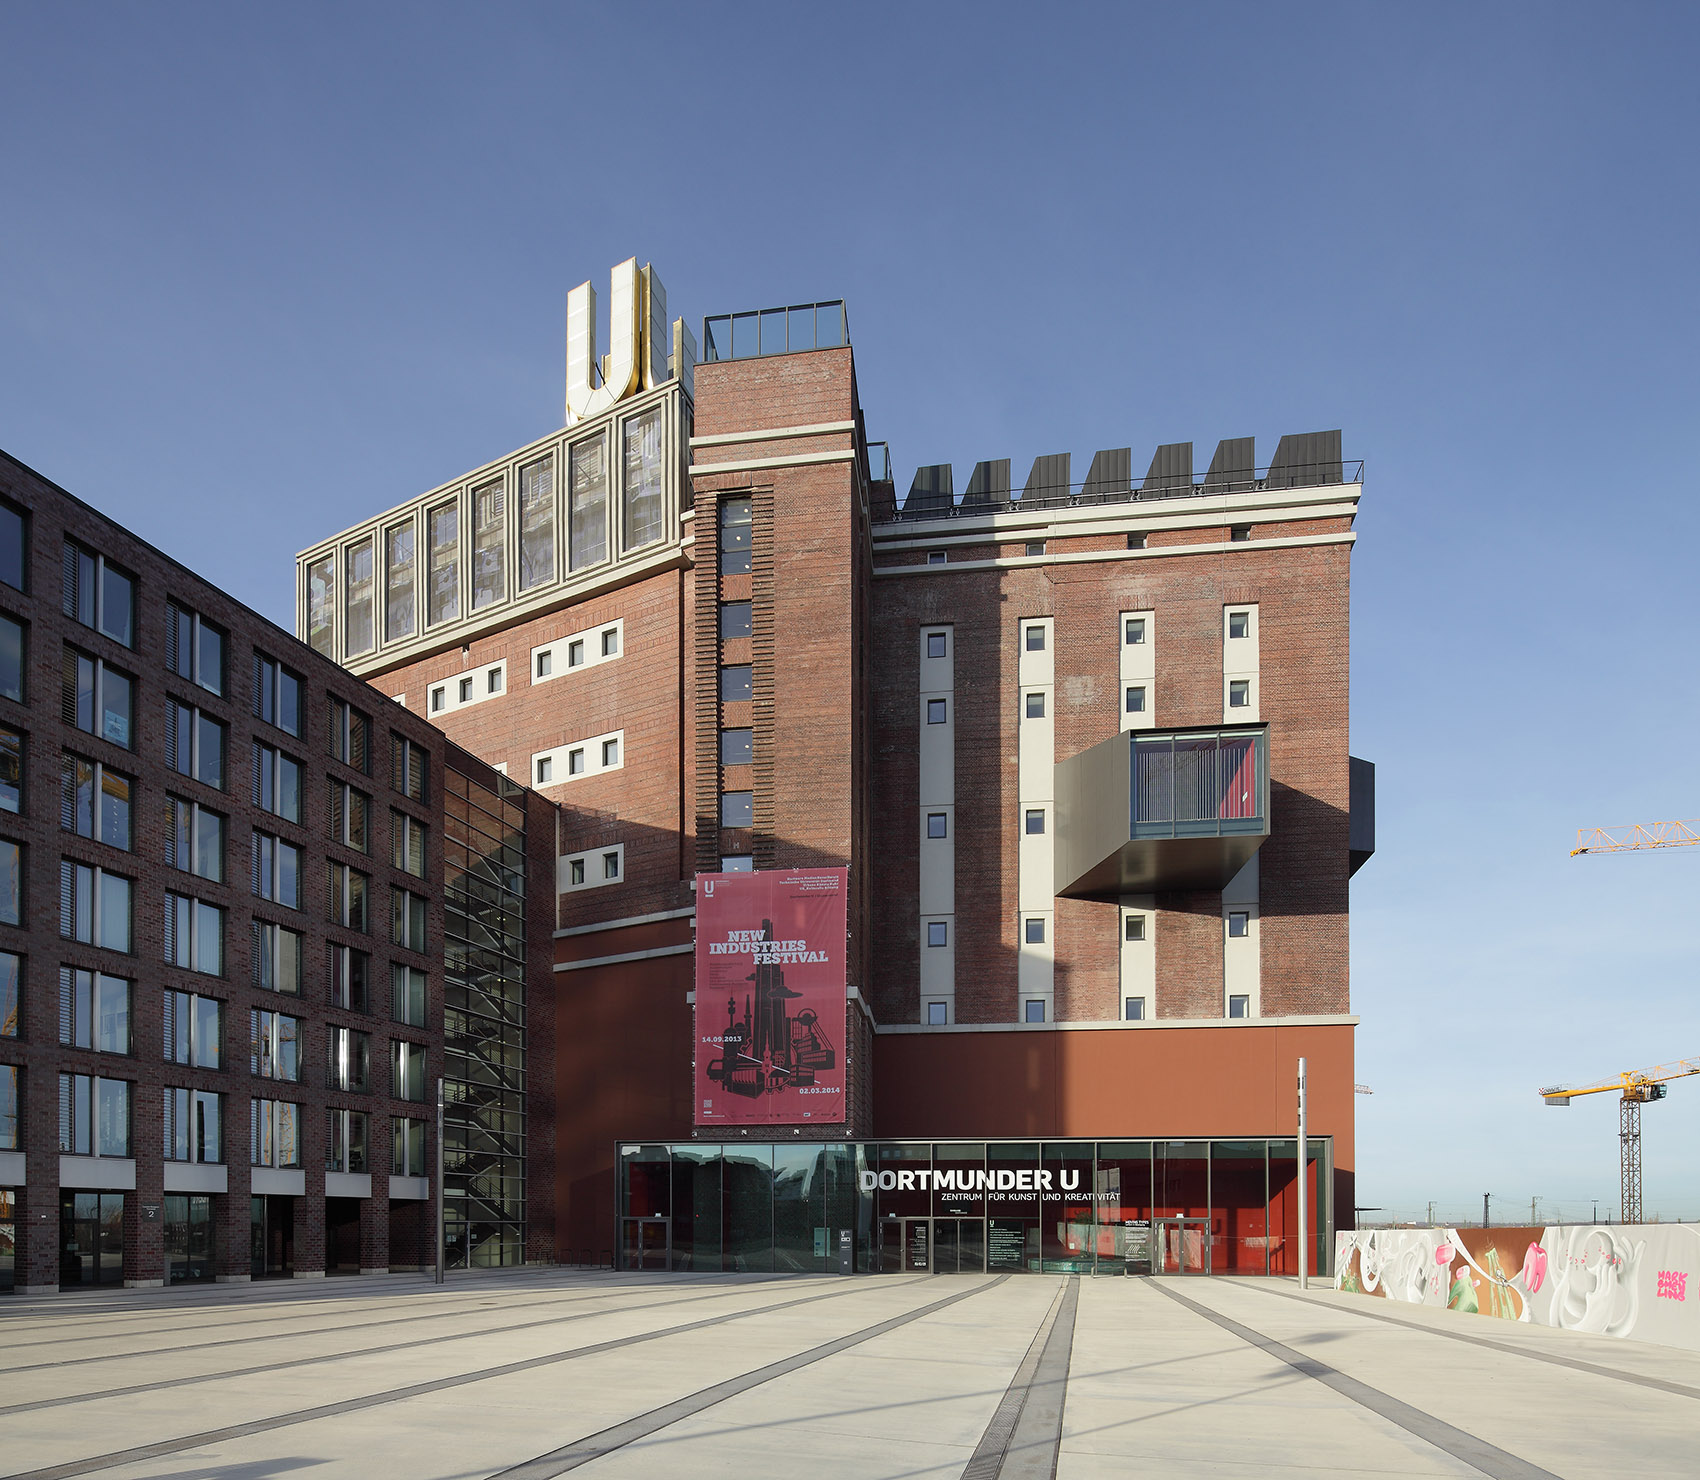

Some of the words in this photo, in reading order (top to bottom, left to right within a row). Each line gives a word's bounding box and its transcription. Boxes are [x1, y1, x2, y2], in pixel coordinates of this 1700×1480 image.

[727, 930, 766, 942] NEW
[709, 940, 807, 954] INDUSTRIES
[753, 950, 829, 965] FESTIVAL
[799, 1087, 840, 1095] 02.03.2014
[860, 1169, 1053, 1191] DORTMUNDER
[1060, 1169, 1080, 1191] U
[941, 1192, 983, 1201] ZENTRUM
[988, 1191, 1006, 1201] FÜR
[1008, 1192, 1038, 1201] KUNST
[1042, 1192, 1061, 1201] UND
[1064, 1191, 1121, 1201] KREATIVITÄT
[148, 1210, 155, 1218] 2
[1657, 1270, 1688, 1281] MARK
